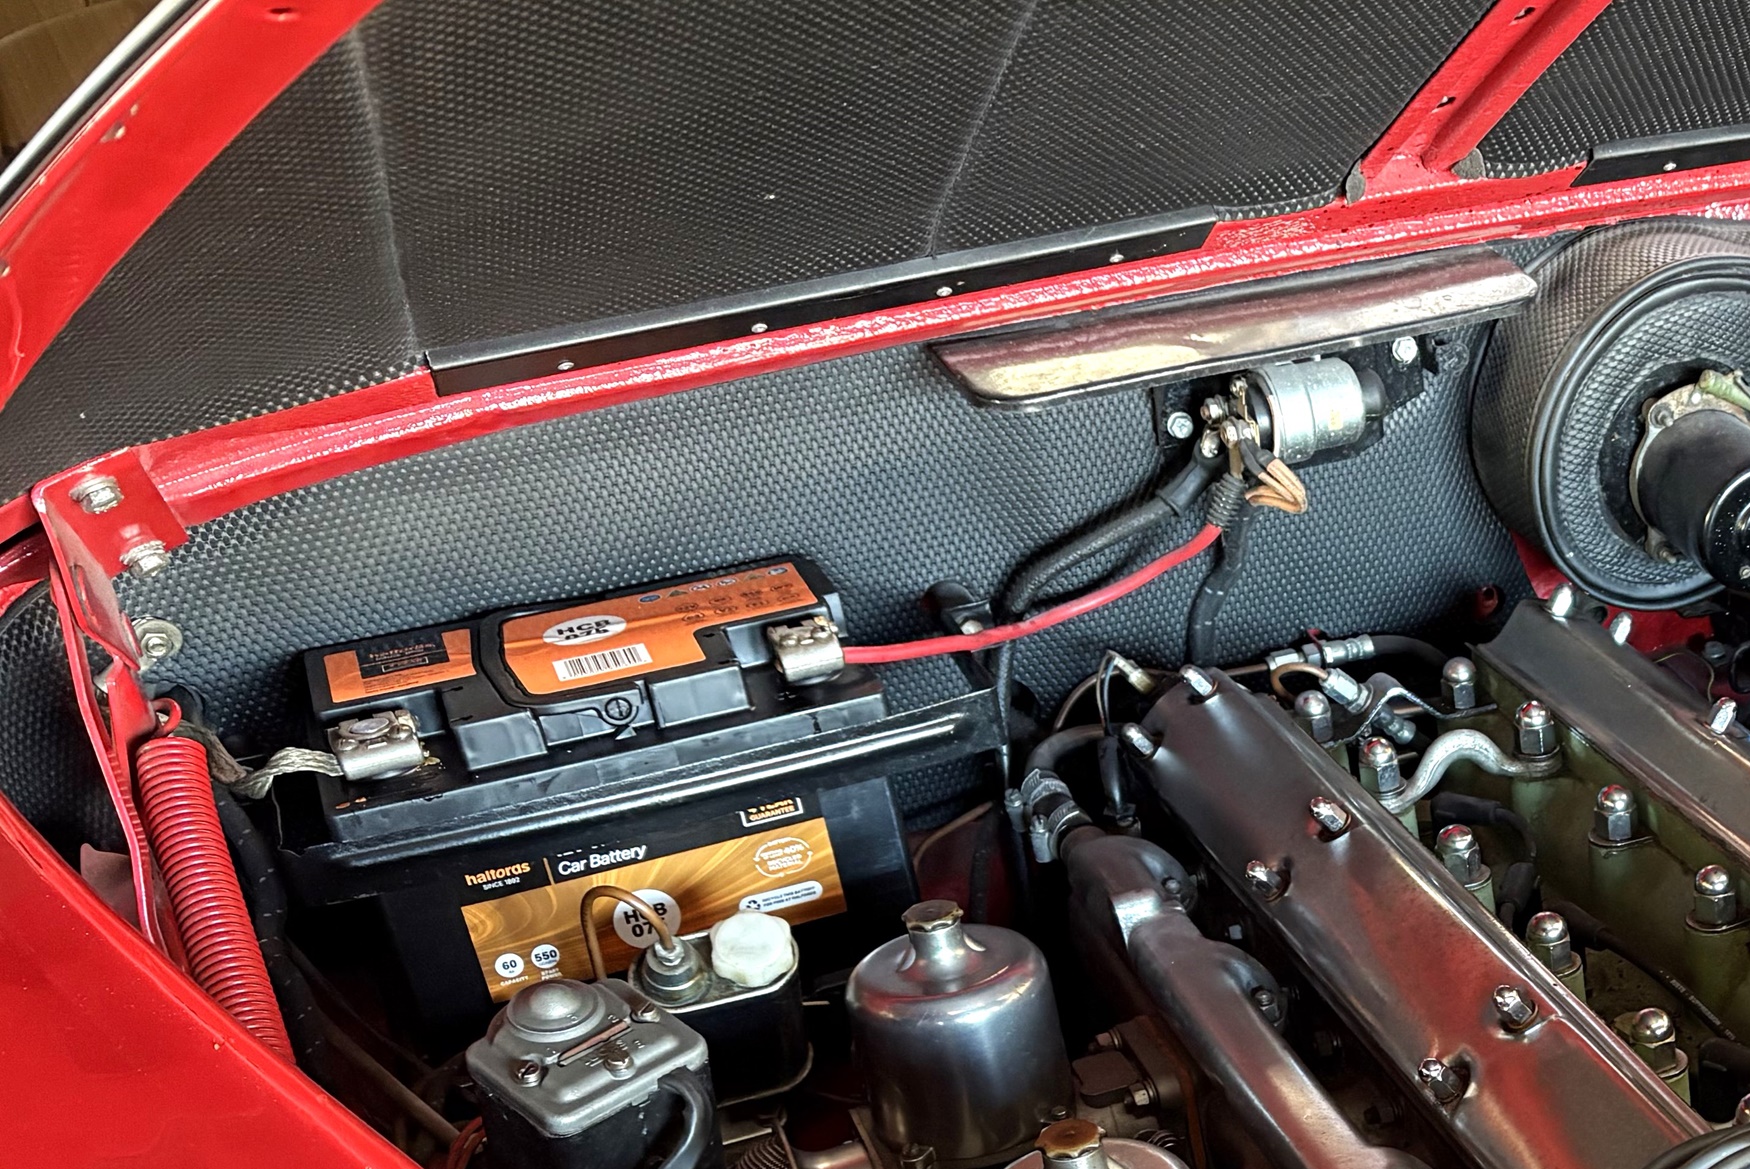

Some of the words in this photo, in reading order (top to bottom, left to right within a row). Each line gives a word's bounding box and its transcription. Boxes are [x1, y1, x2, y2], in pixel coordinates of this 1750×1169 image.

[749, 805, 795, 821] GUARANTEE
[558, 859, 587, 876] Car
[589, 845, 647, 869] Battery
[464, 861, 531, 887] halfords
[482, 881, 503, 891] SINCE
[534, 949, 557, 963] 550
[502, 959, 517, 971] 60
[500, 975, 530, 987] CAPACITY
